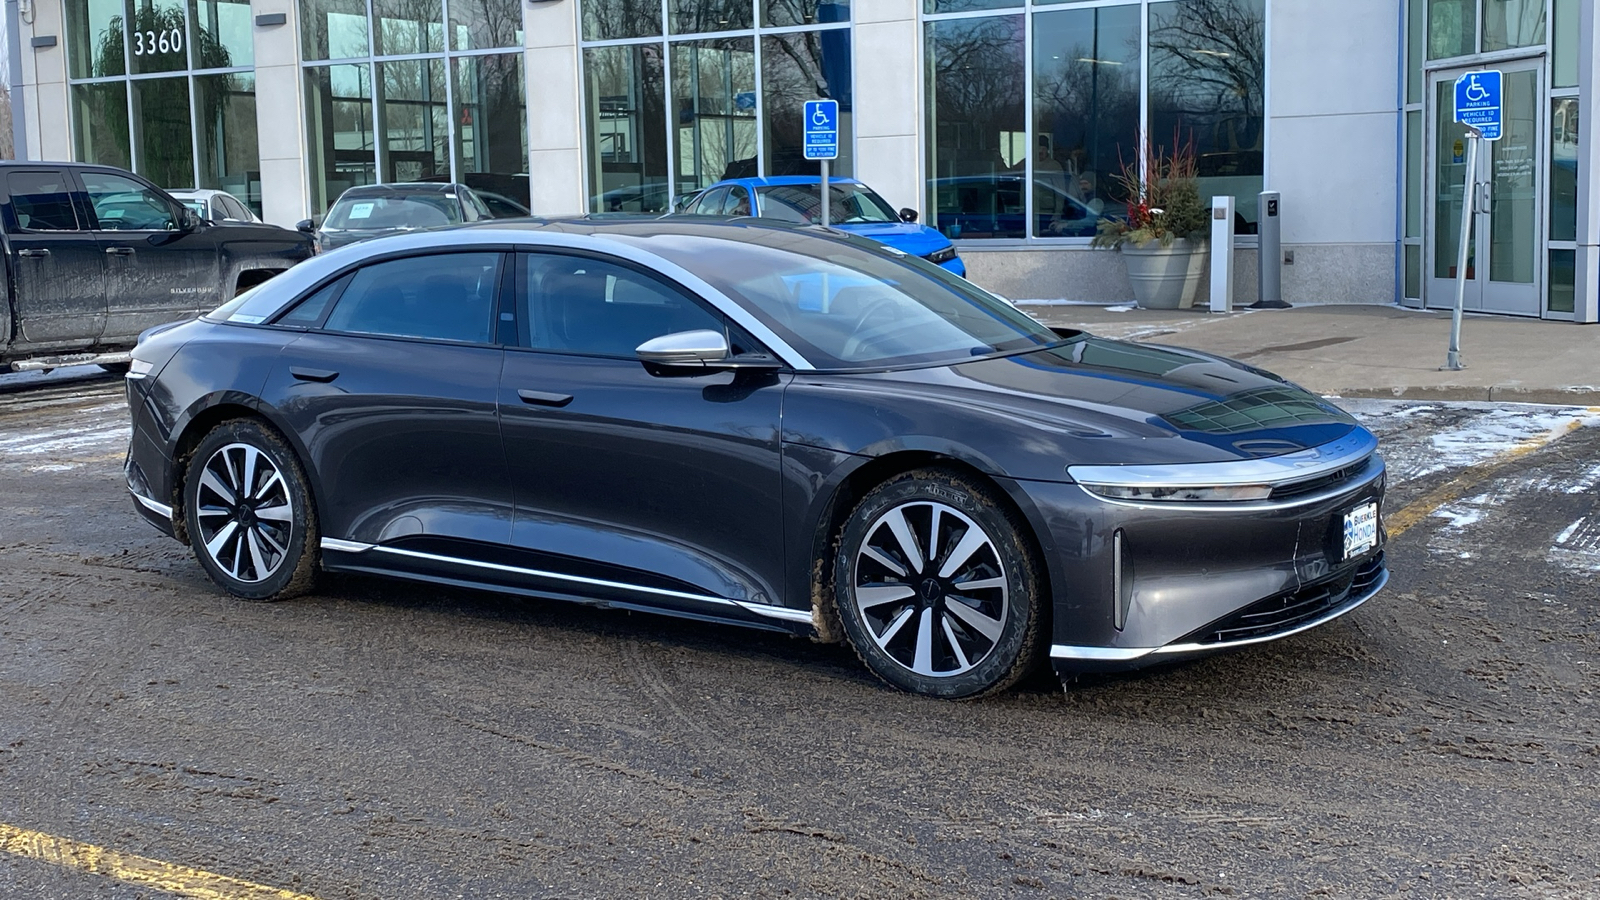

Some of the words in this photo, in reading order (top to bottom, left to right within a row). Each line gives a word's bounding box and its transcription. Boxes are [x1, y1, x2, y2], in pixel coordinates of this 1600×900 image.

[134, 28, 182, 56] 3360
[1354, 510, 1376, 526] BUERKLE
[1353, 522, 1376, 544] HONDA
